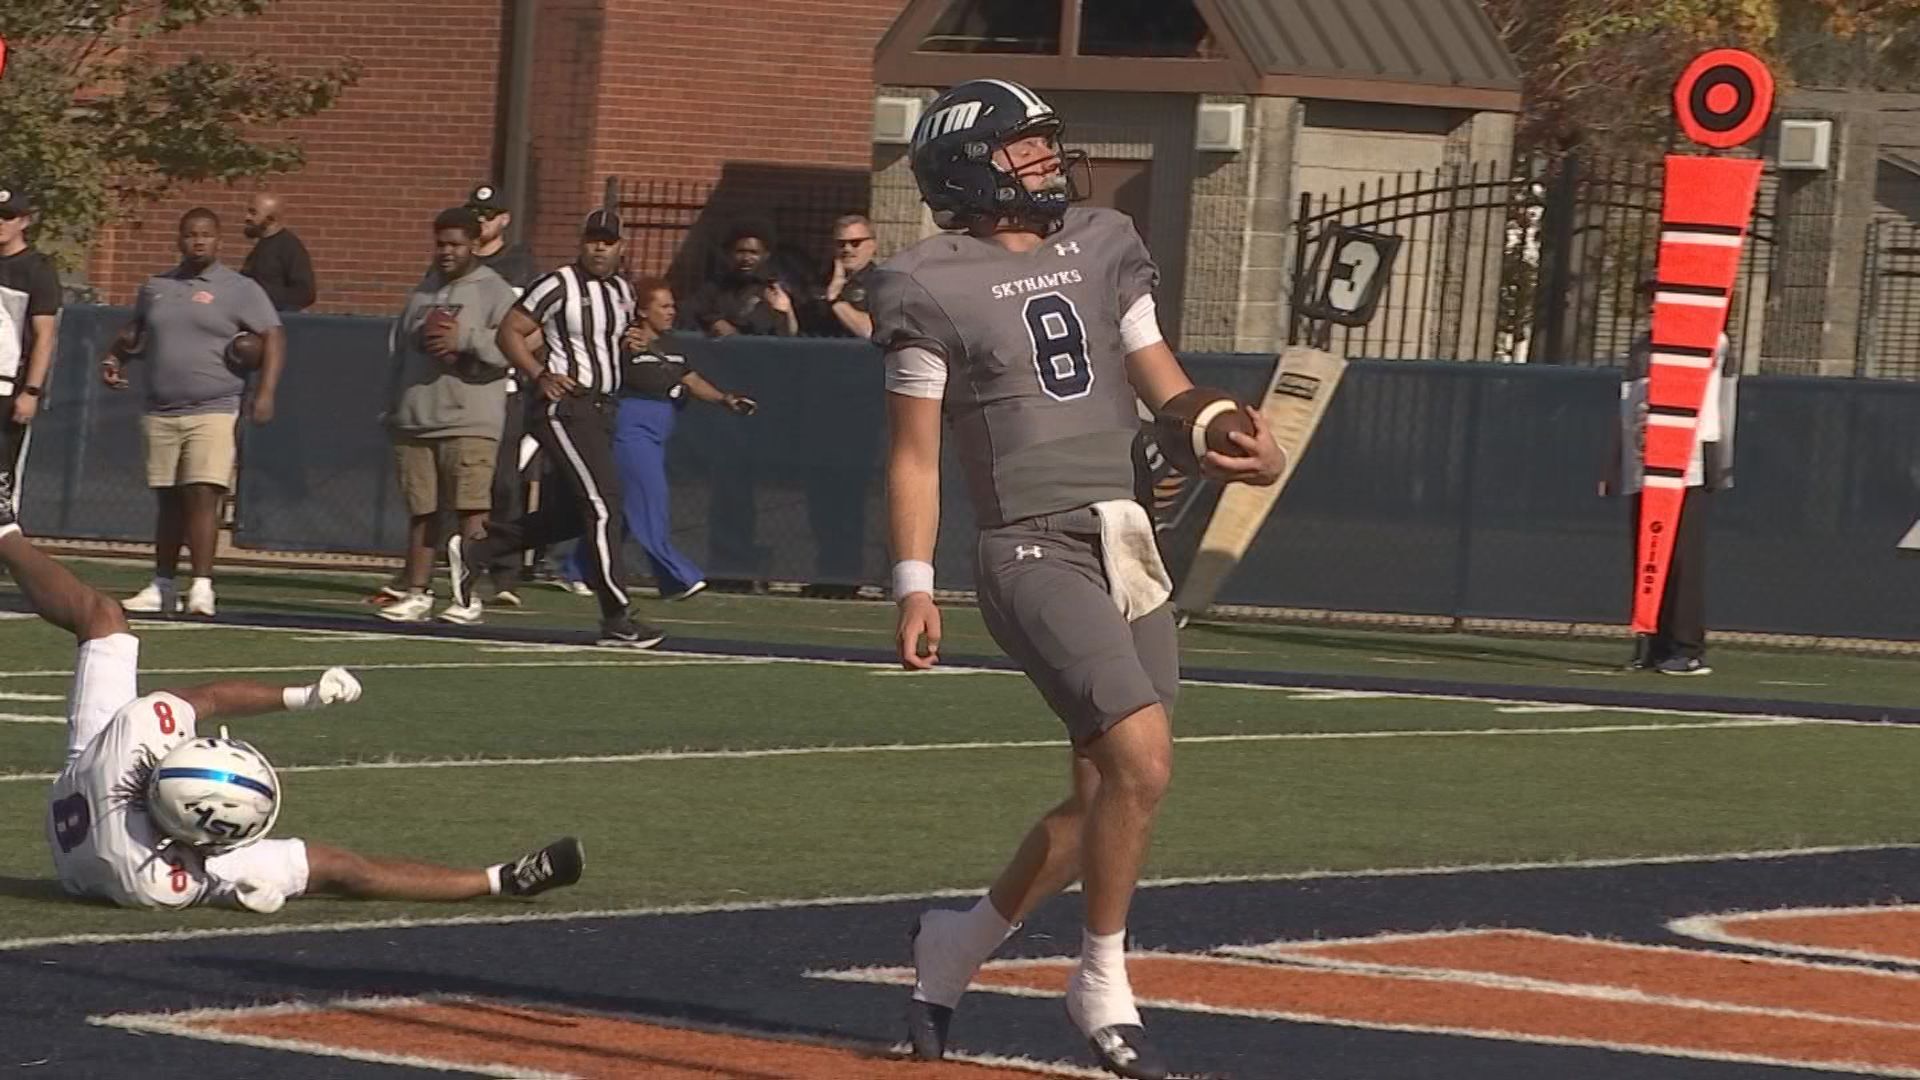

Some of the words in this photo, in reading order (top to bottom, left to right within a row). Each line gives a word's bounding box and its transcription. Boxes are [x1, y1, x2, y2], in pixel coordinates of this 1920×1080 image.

[991, 269, 1082, 299] SKYHAWKS
[1328, 240, 1380, 312] 3
[1022, 291, 1095, 402] 8
[153, 701, 176, 735] 8
